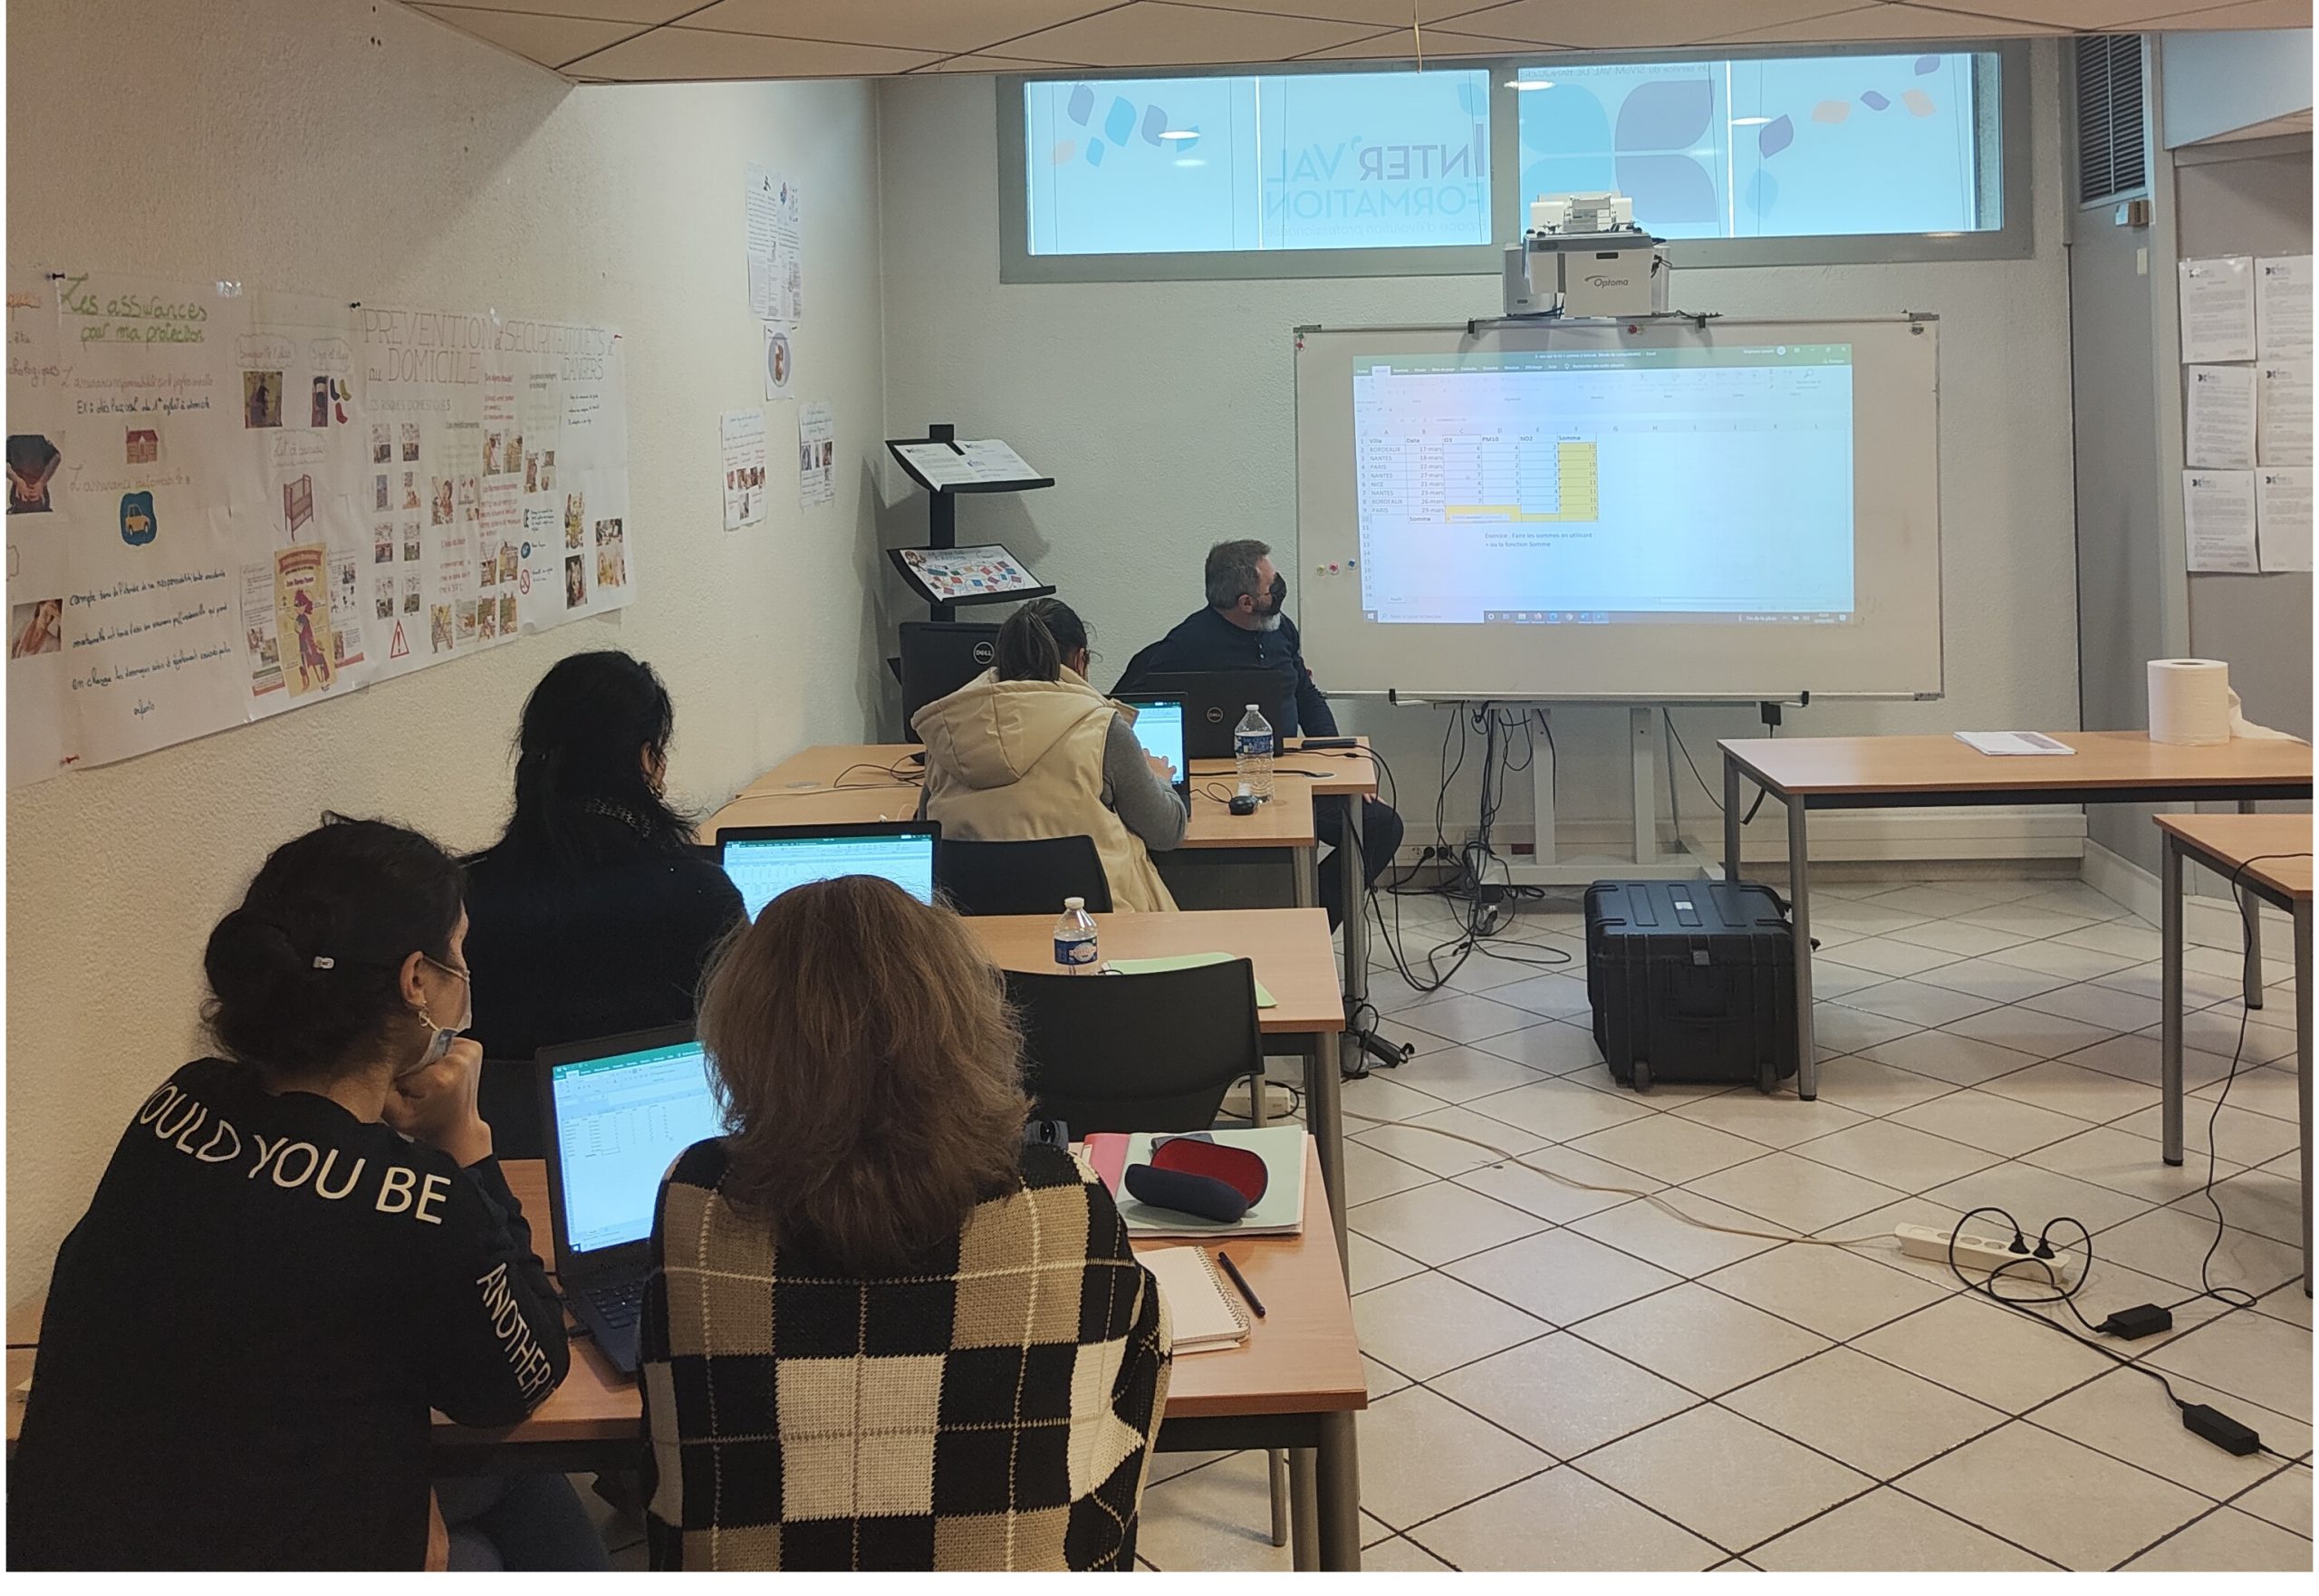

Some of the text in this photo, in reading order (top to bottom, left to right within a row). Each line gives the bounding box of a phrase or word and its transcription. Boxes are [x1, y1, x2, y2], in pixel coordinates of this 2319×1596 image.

[61, 272, 99, 315] Les
[107, 294, 208, 322] assurances
[1594, 277, 1629, 289] Optoma
[82, 322, 111, 352] pour
[116, 324, 140, 341] ma
[388, 347, 481, 386] DOMICILE
[140, 1082, 452, 1225] OULD YOU BE
